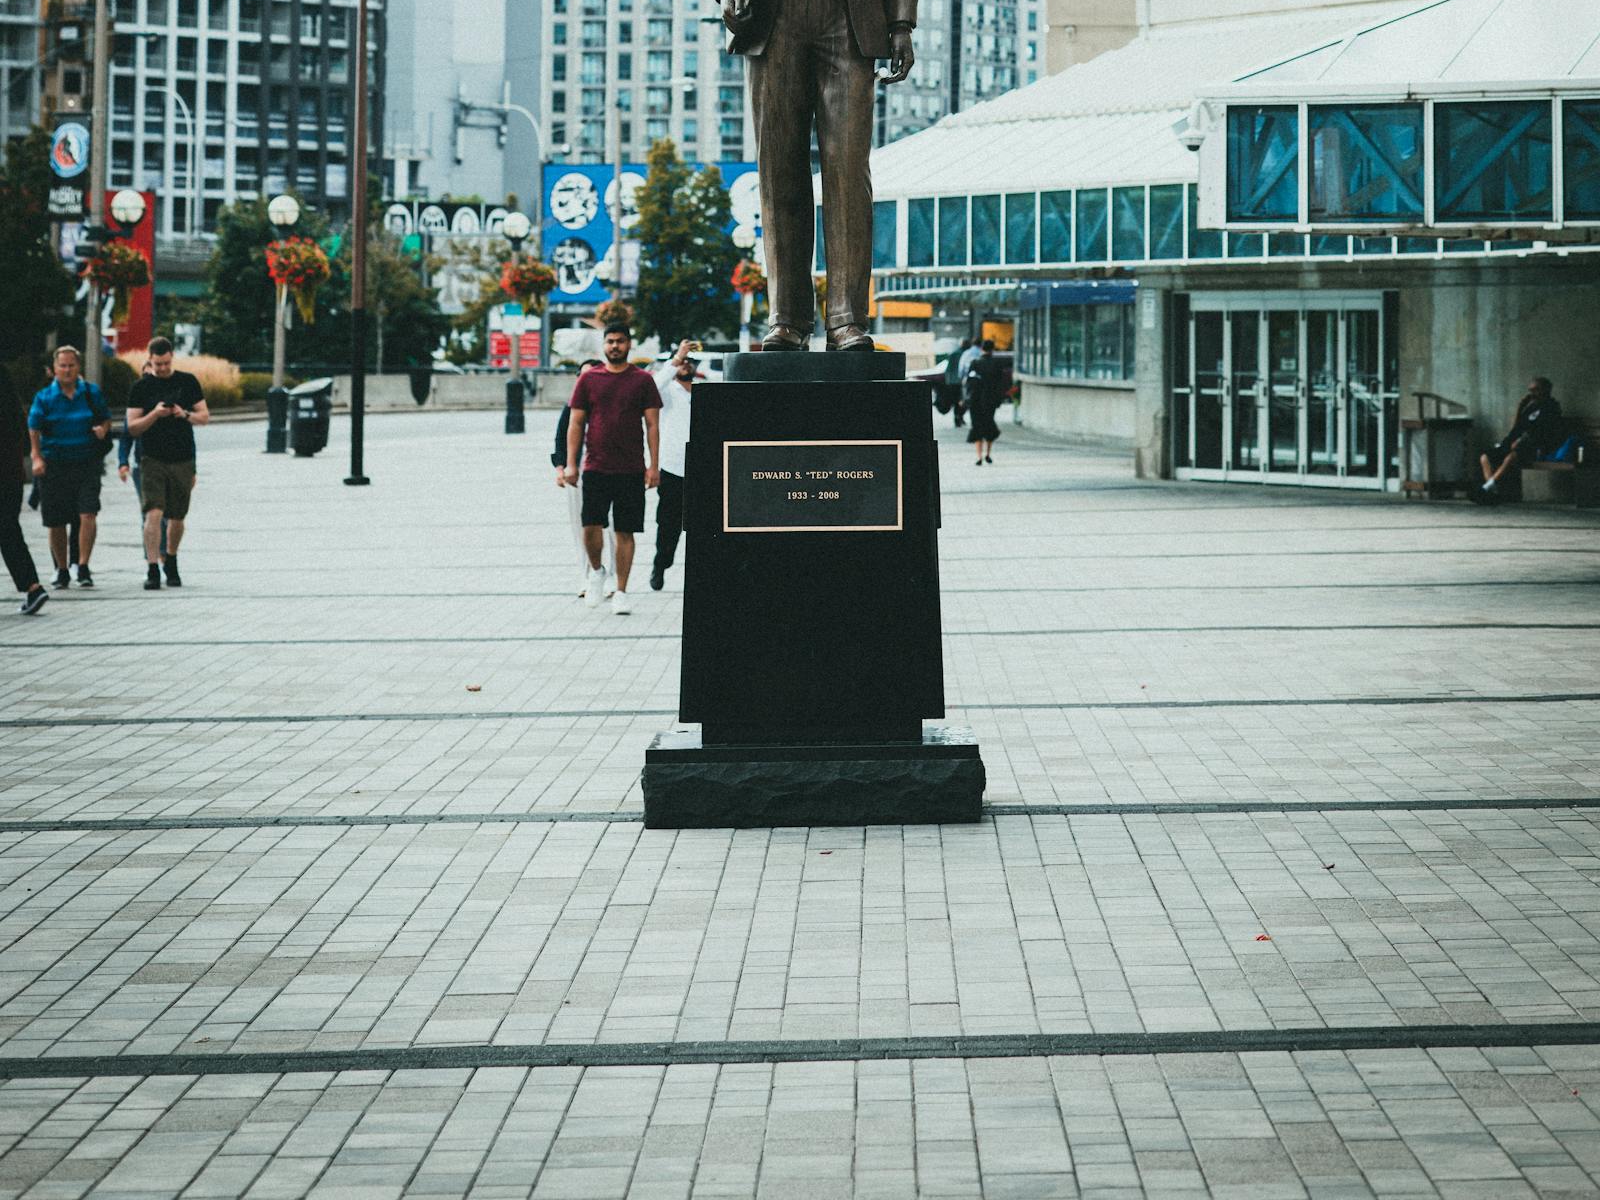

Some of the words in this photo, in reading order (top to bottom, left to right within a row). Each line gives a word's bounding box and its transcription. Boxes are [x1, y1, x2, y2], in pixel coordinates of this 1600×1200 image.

[752, 471, 791, 479] EDWARD
[795, 471, 802, 479] S.
[806, 471, 832, 479] "TED"
[837, 471, 874, 479] ROGERS
[787, 491, 808, 500] 1933
[818, 491, 840, 500] 2008
